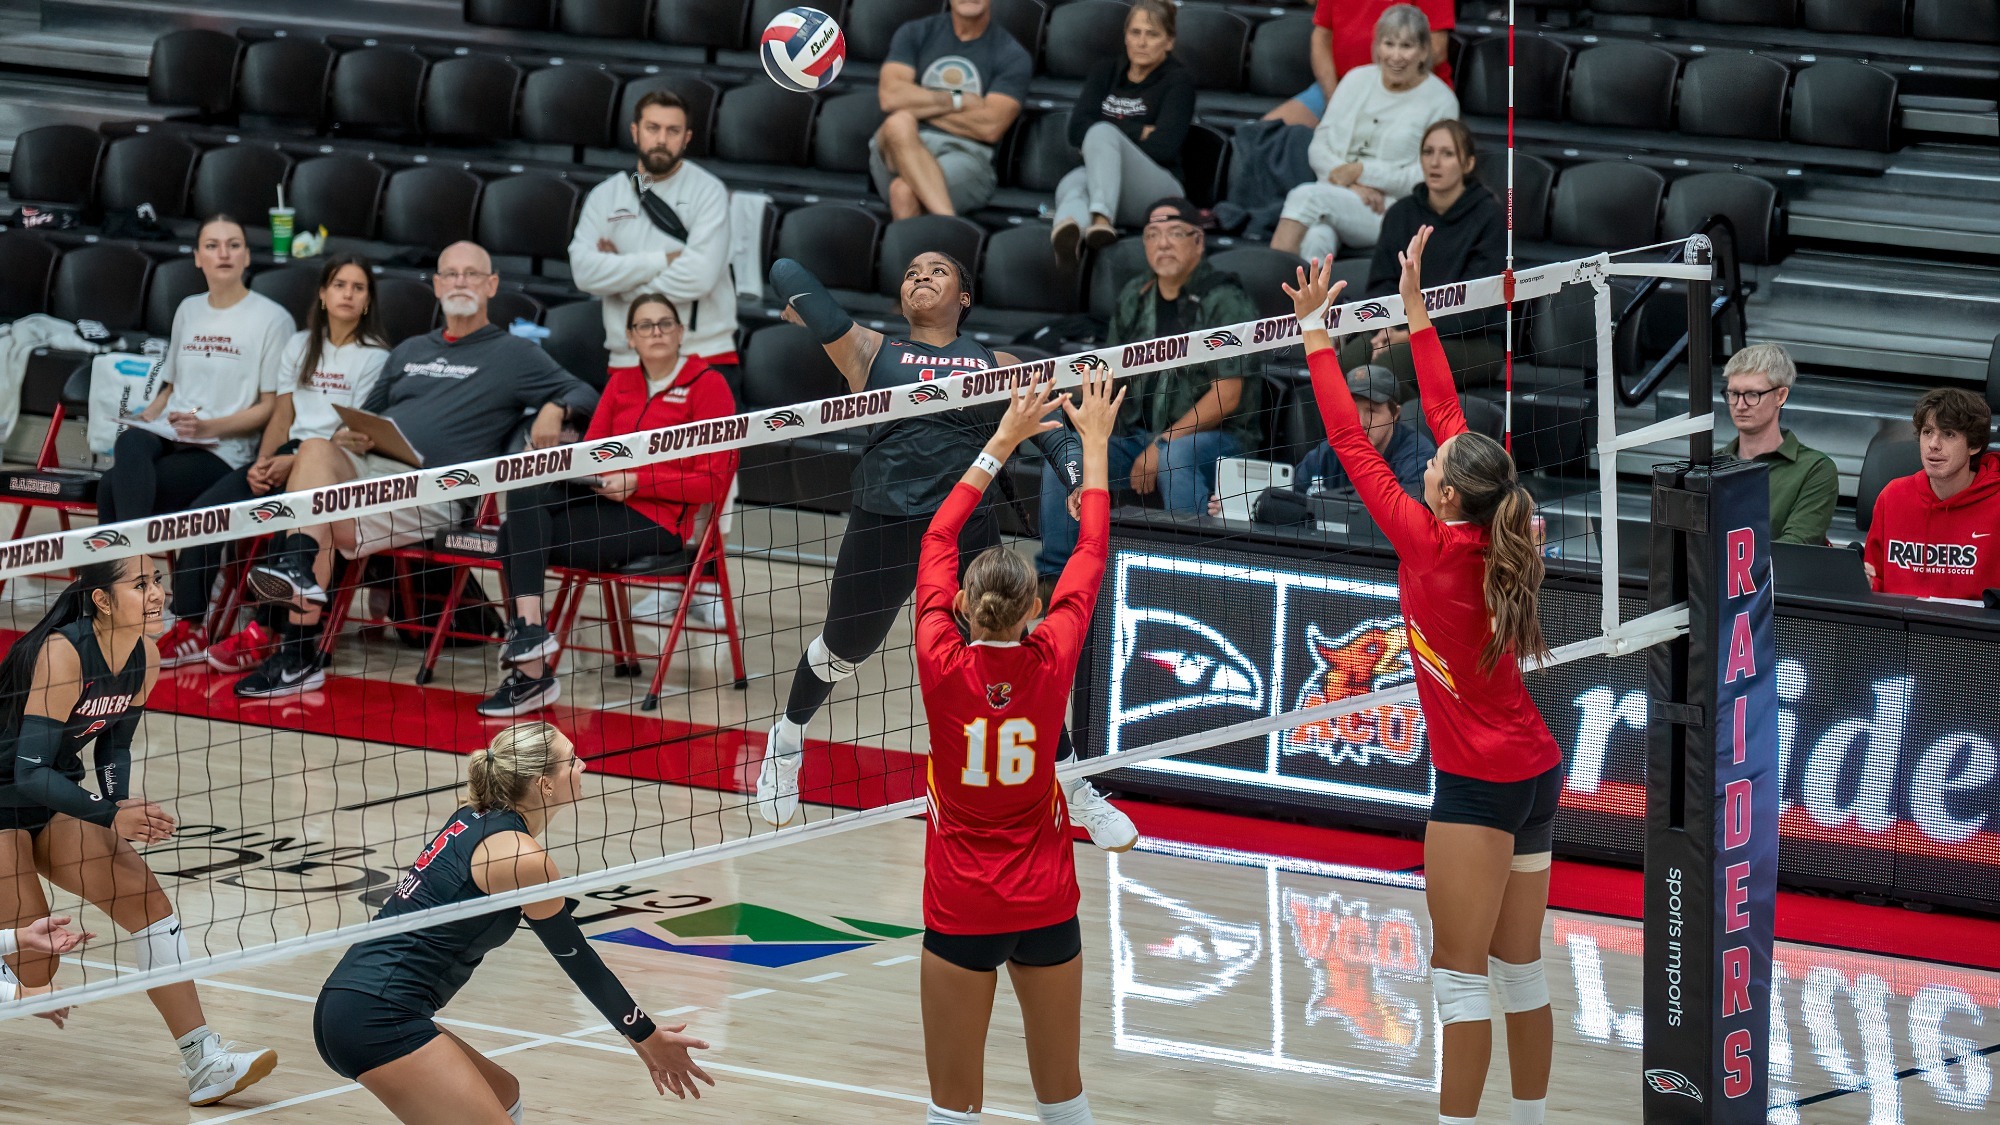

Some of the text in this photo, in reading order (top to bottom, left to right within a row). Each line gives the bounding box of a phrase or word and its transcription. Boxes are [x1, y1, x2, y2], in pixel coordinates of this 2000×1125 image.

[810, 27, 834, 57] Baden
[901, 352, 989, 369] RAIDERS
[147, 508, 231, 543] OREGON
[312, 475, 419, 515] SOUTHERN
[495, 448, 573, 483] OREGON
[648, 416, 749, 455] SOUTHERN
[820, 390, 892, 424] OREGON
[962, 360, 1056, 398] SOUTHERN
[1121, 336, 1189, 368] OREGON
[1253, 307, 1342, 343] SOUTN
[1404, 284, 1466, 315] EGON
[10, 477, 61, 494] RAIDERS
[1888, 539, 1977, 569] RAIDERS
[76, 694, 132, 716] RAIDERS
[1291, 694, 1420, 753] ACU
[961, 717, 1037, 787] 16
[1722, 527, 1758, 1099] RAIDERS
[1665, 867, 1683, 1027] sports imports
